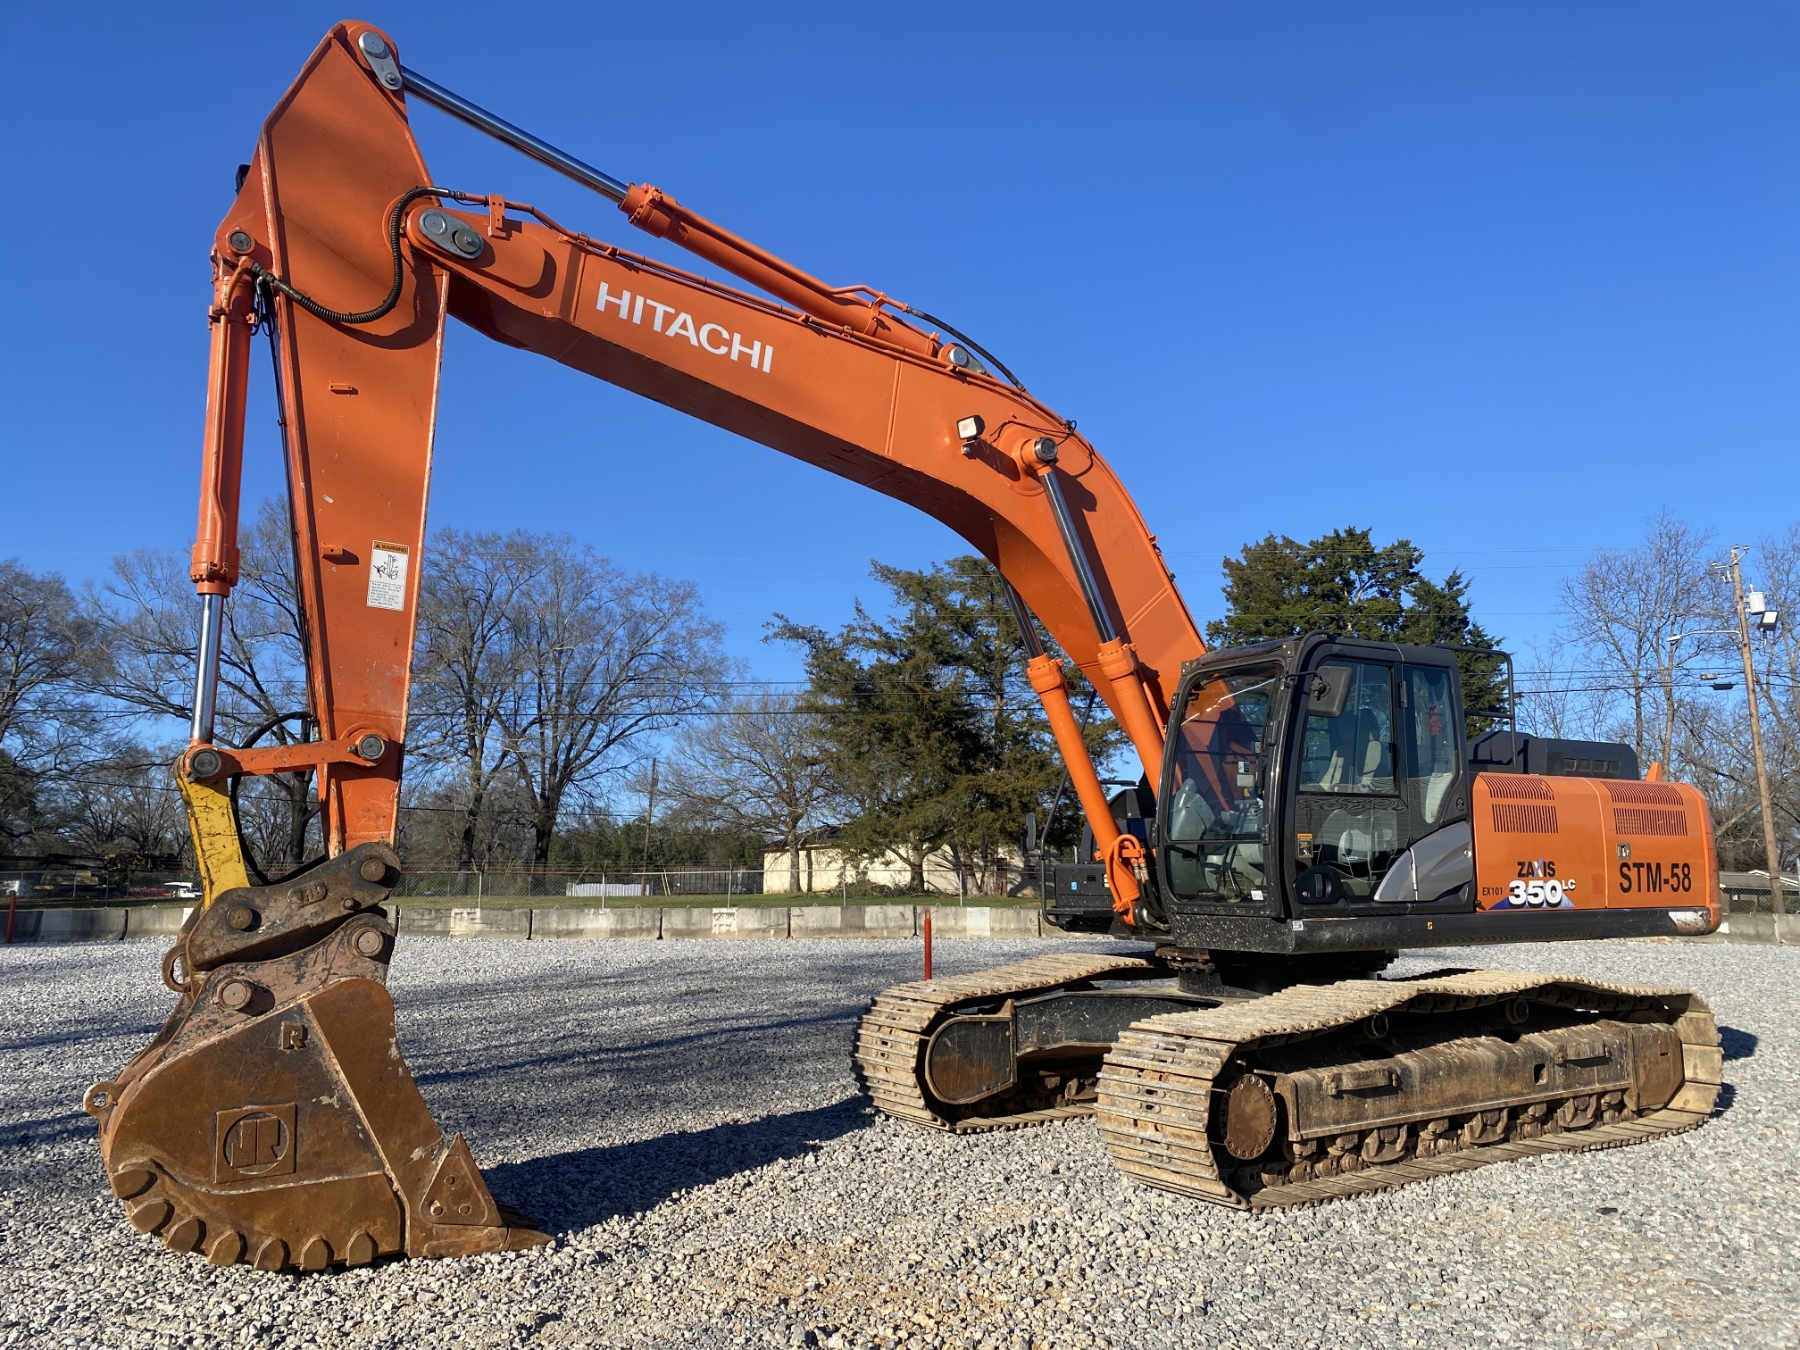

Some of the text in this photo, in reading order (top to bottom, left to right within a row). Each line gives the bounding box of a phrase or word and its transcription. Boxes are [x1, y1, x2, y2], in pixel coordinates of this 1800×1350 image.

[596, 281, 774, 373] HITACHI
[381, 544, 407, 553] WARNING
[1517, 857, 1556, 878] ZAXIS
[1619, 862, 1692, 893] STM-58
[1482, 887, 1503, 896] EX101
